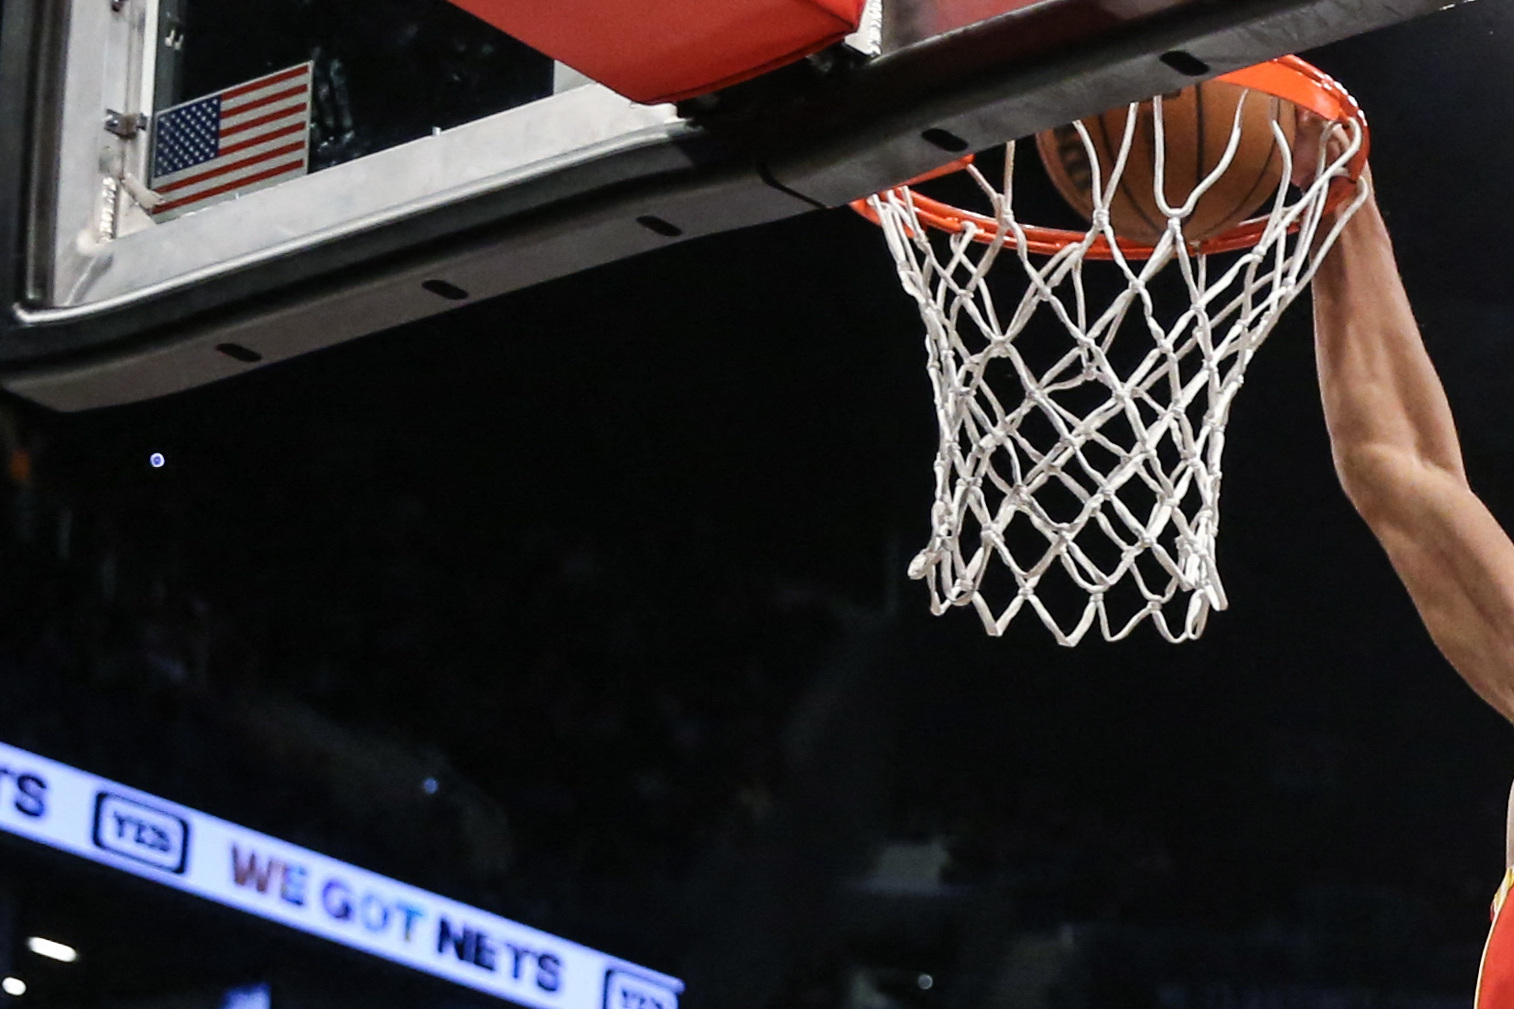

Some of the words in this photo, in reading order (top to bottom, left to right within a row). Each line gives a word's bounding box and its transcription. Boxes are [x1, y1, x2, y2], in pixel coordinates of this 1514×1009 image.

[231, 844, 307, 906] WE
[321, 878, 424, 943] GOT
[437, 914, 561, 993] NETS
